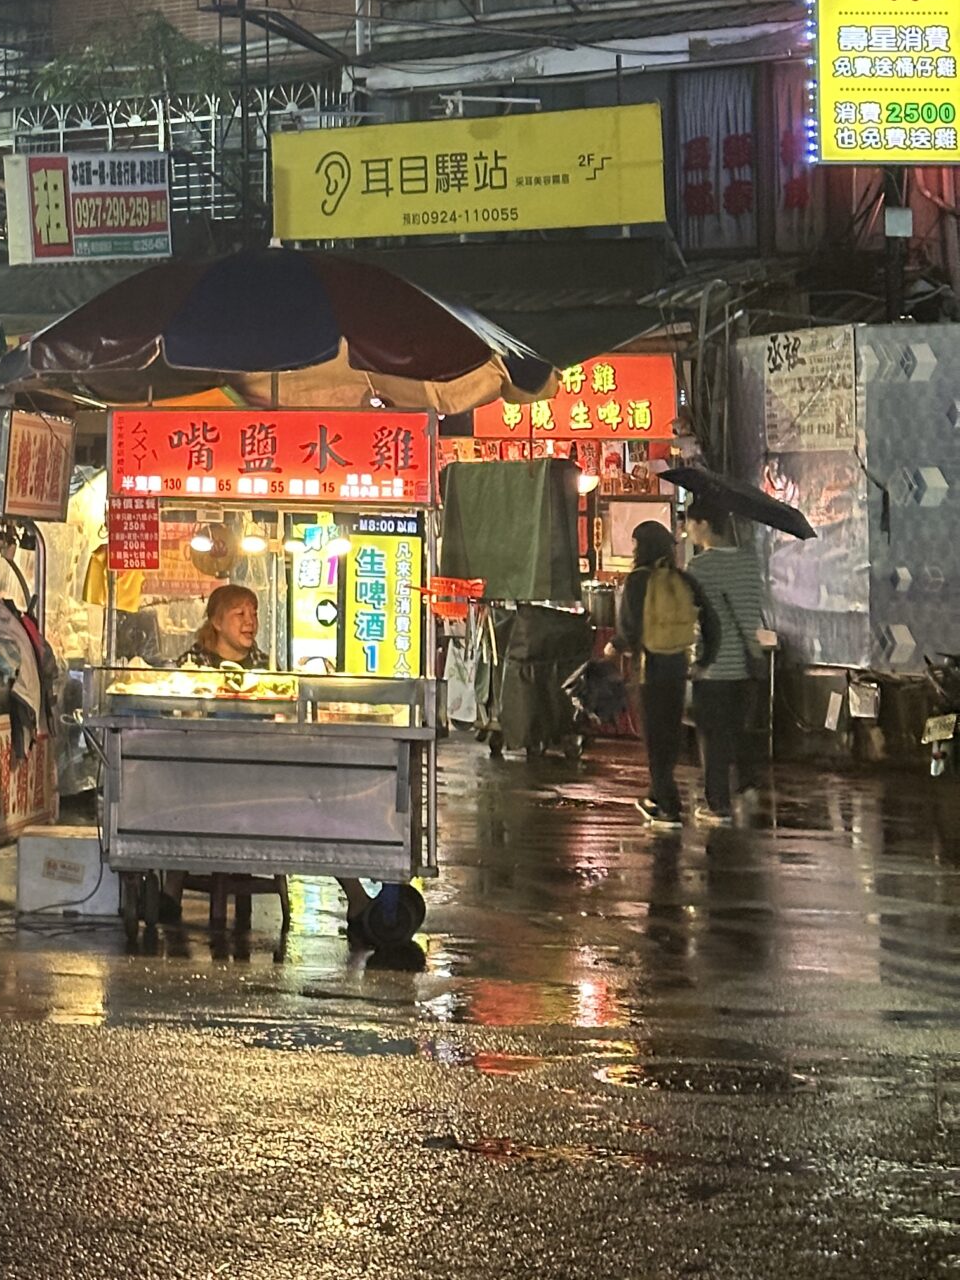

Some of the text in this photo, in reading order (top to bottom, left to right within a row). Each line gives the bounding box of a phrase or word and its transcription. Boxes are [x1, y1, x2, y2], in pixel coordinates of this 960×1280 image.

[837, 25, 951, 52] 壽星消費
[832, 56, 957, 78] 免費送桶仔雞
[834, 101, 956, 124] 消費2500
[834, 127, 958, 150] 也免費送雞
[360, 149, 508, 198] 耳目驛站
[578, 153, 595, 167] 2F
[562, 363, 617, 394] 仔雞
[569, 400, 652, 431] 生啤酒
[169, 421, 419, 475] 嘴鹽水雞
